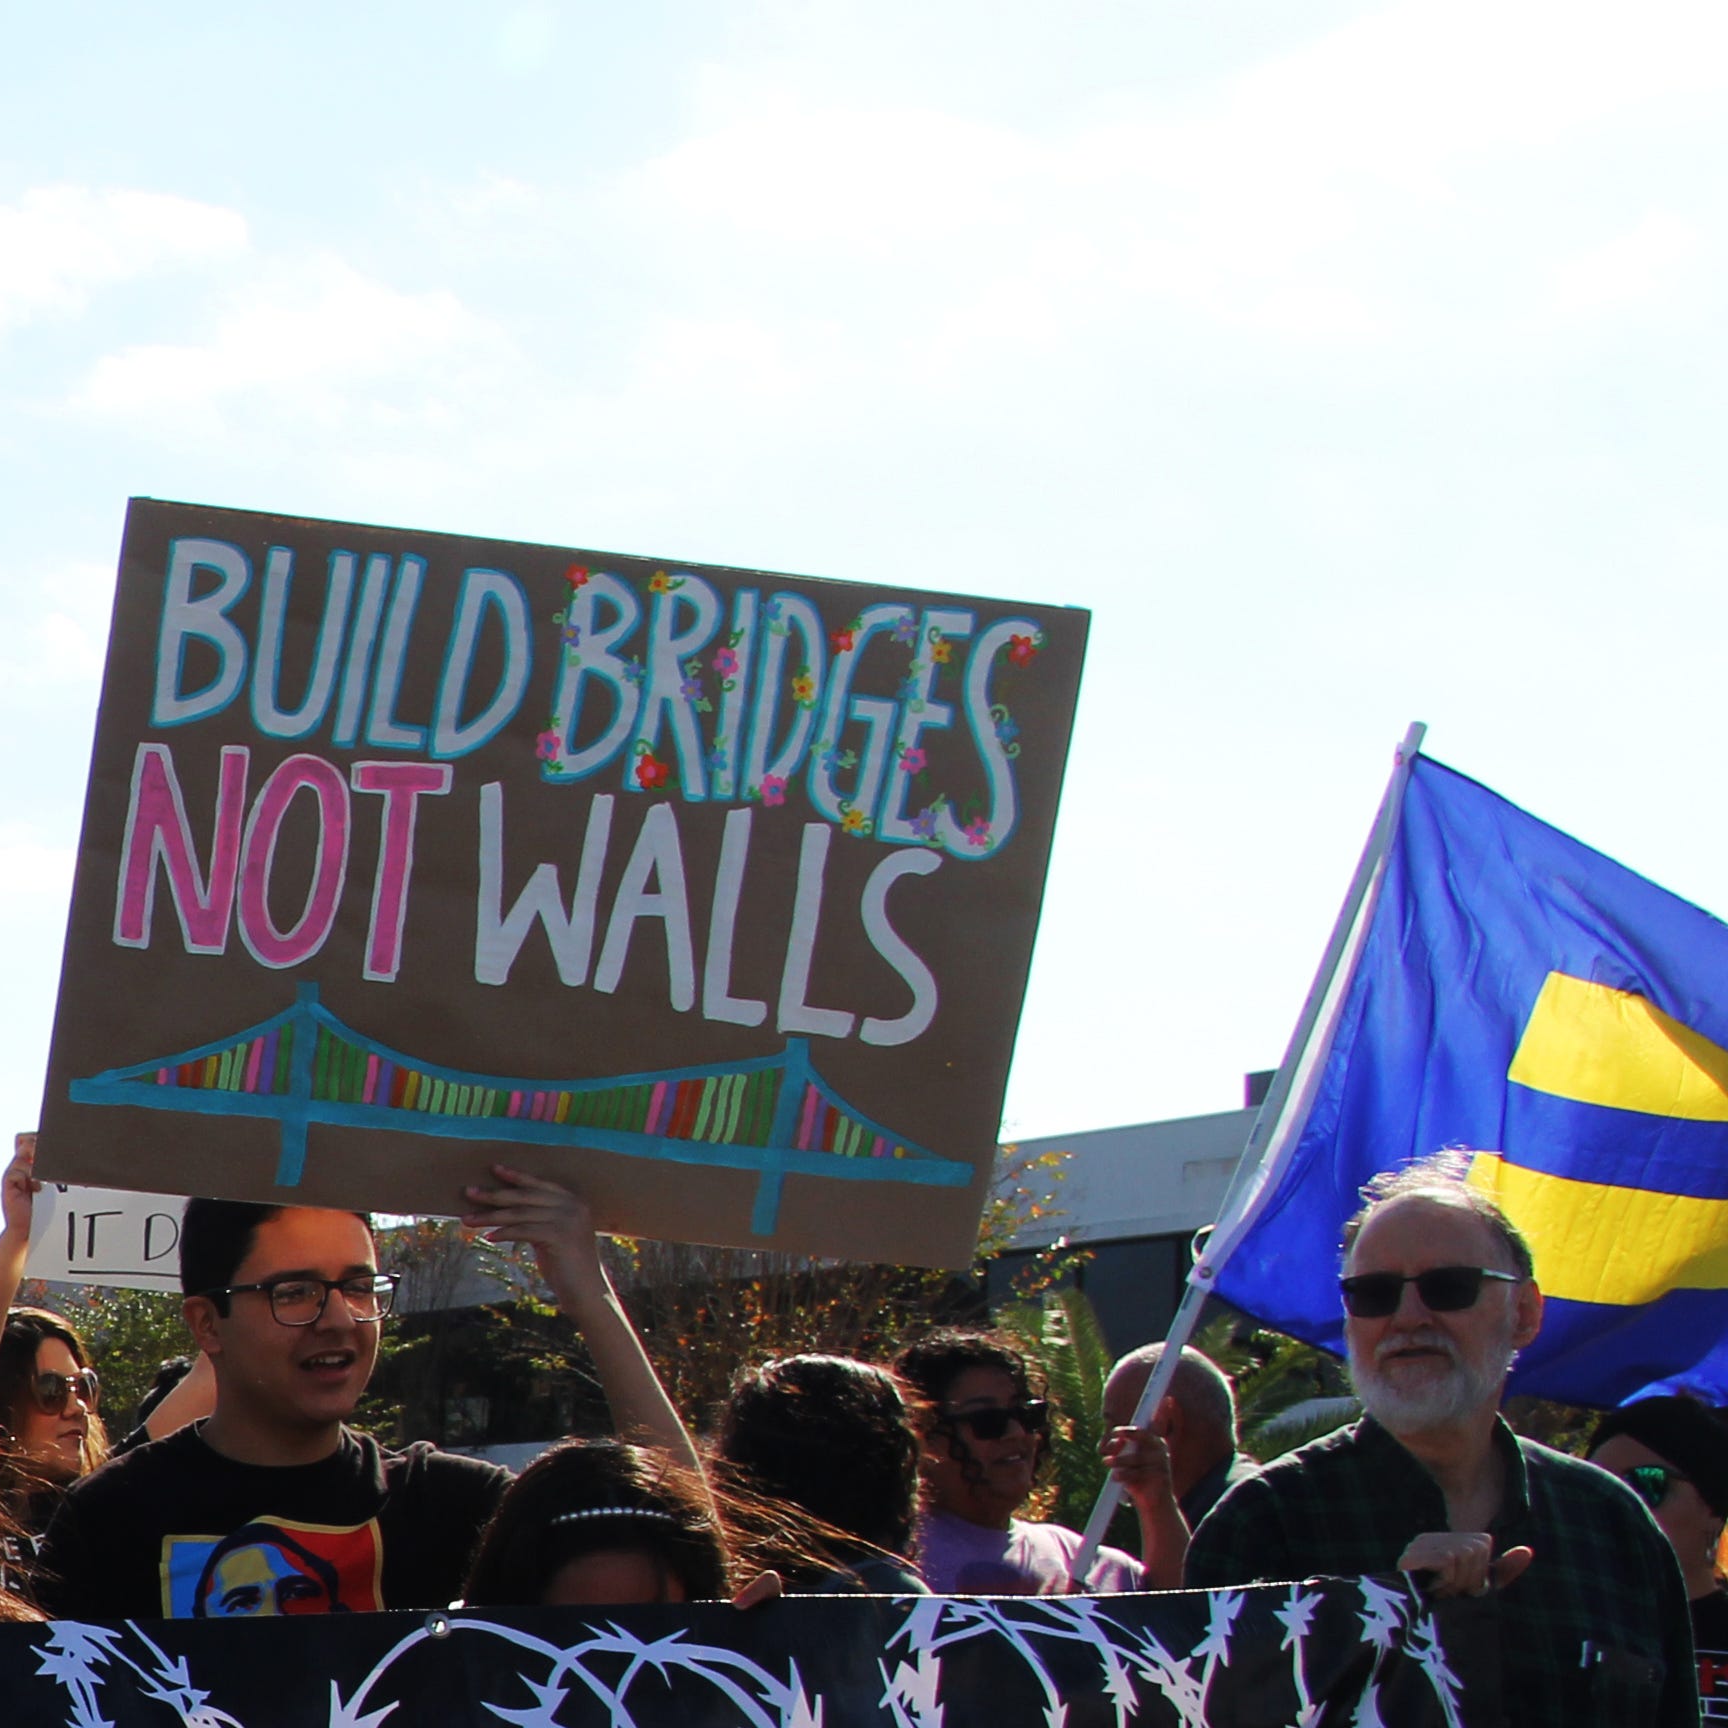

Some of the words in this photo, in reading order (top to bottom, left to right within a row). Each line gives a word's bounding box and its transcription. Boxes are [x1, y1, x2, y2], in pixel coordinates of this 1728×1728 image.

[150, 537, 531, 759] BUILD
[538, 566, 1041, 858] BRIDGES
[113, 742, 452, 983] NOT
[475, 782, 942, 1047] WALLS
[68, 1211, 123, 1261] IT
